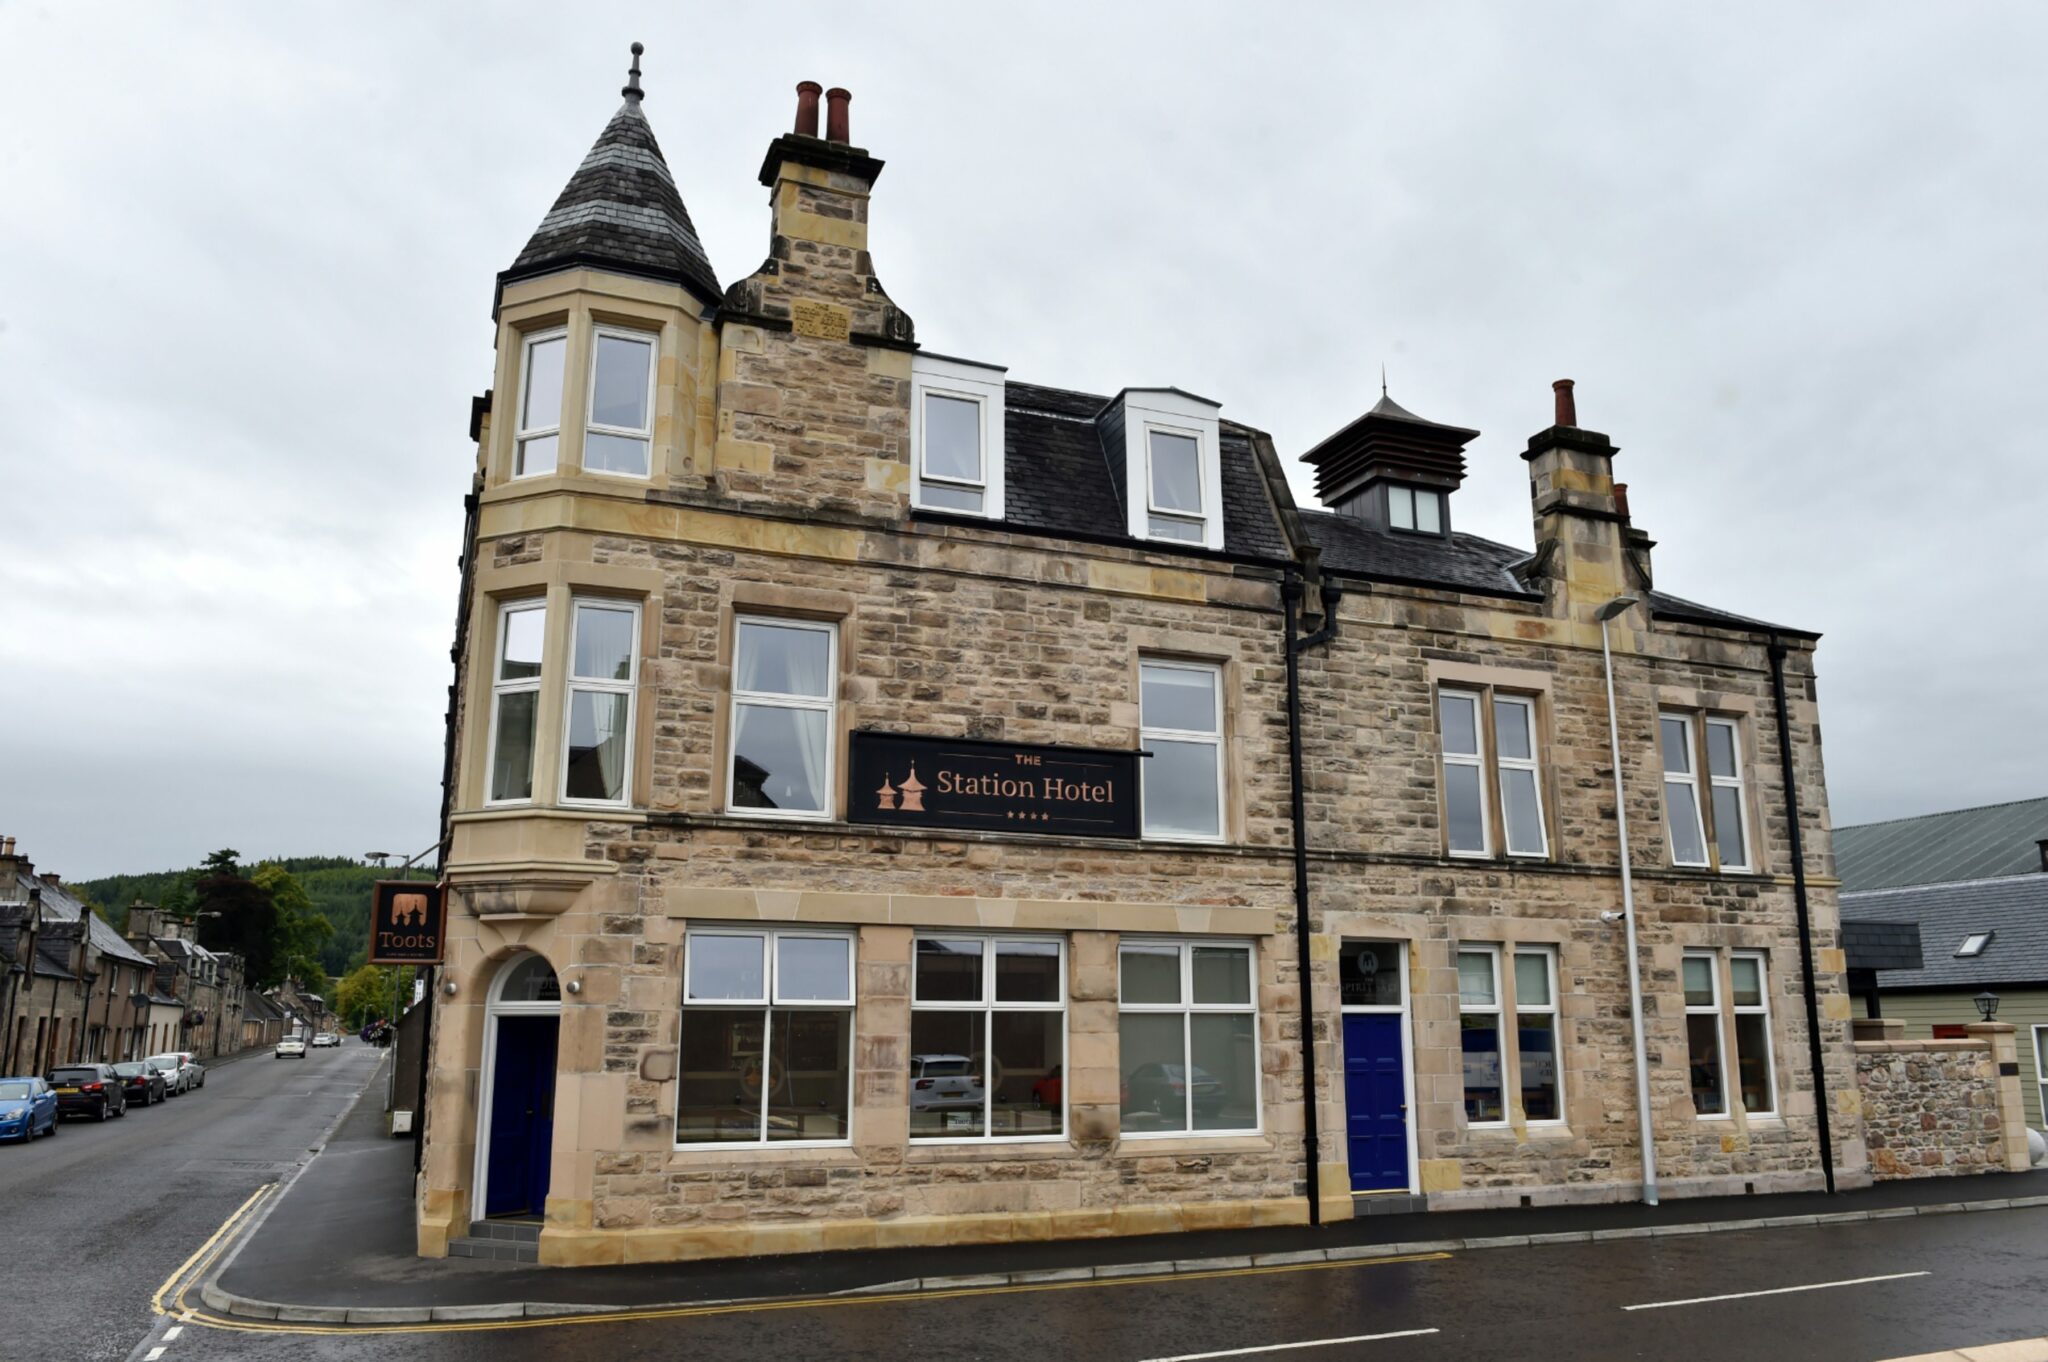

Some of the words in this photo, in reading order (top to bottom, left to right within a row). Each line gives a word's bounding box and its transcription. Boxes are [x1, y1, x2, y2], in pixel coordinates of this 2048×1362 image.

[1015, 754, 1042, 766] THE
[937, 770, 1035, 799] Station
[1043, 777, 1115, 803] Hotel
[379, 931, 436, 948] Toots
